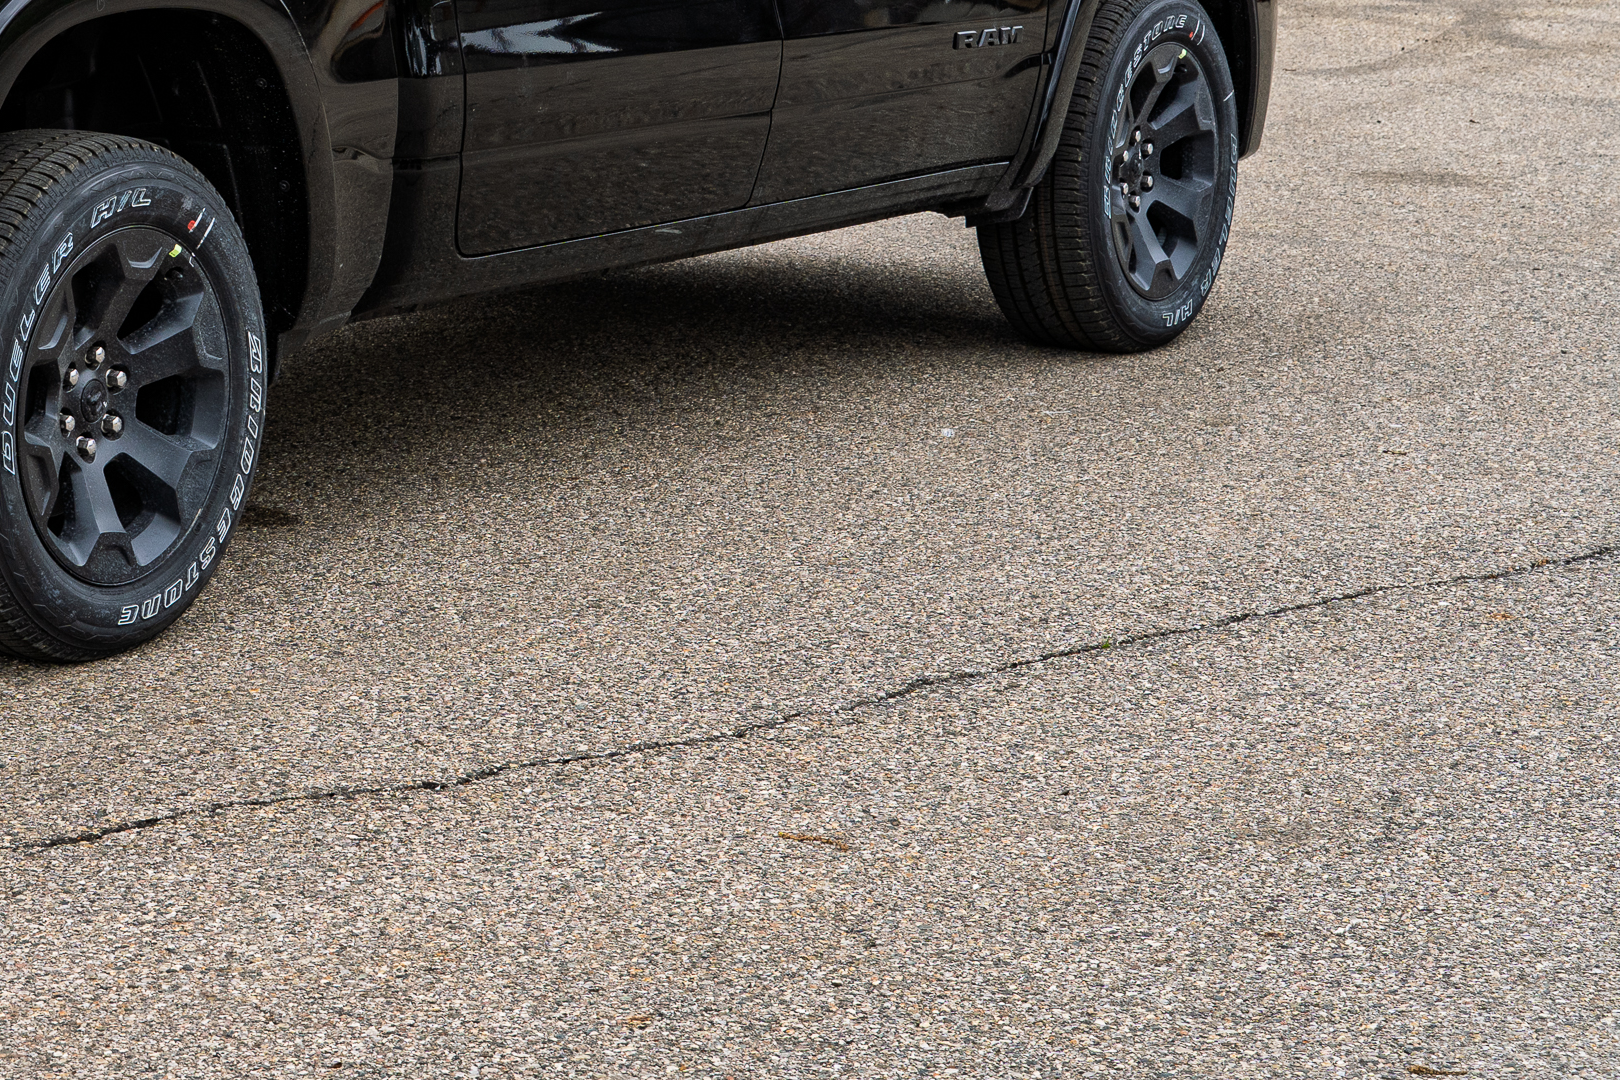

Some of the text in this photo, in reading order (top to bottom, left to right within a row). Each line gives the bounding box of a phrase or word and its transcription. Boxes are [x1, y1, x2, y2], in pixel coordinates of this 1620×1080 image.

[953, 25, 1023, 50] RAM
[2, 187, 152, 475] DUELER H/L
[117, 331, 262, 626] BRIDGESTONE
